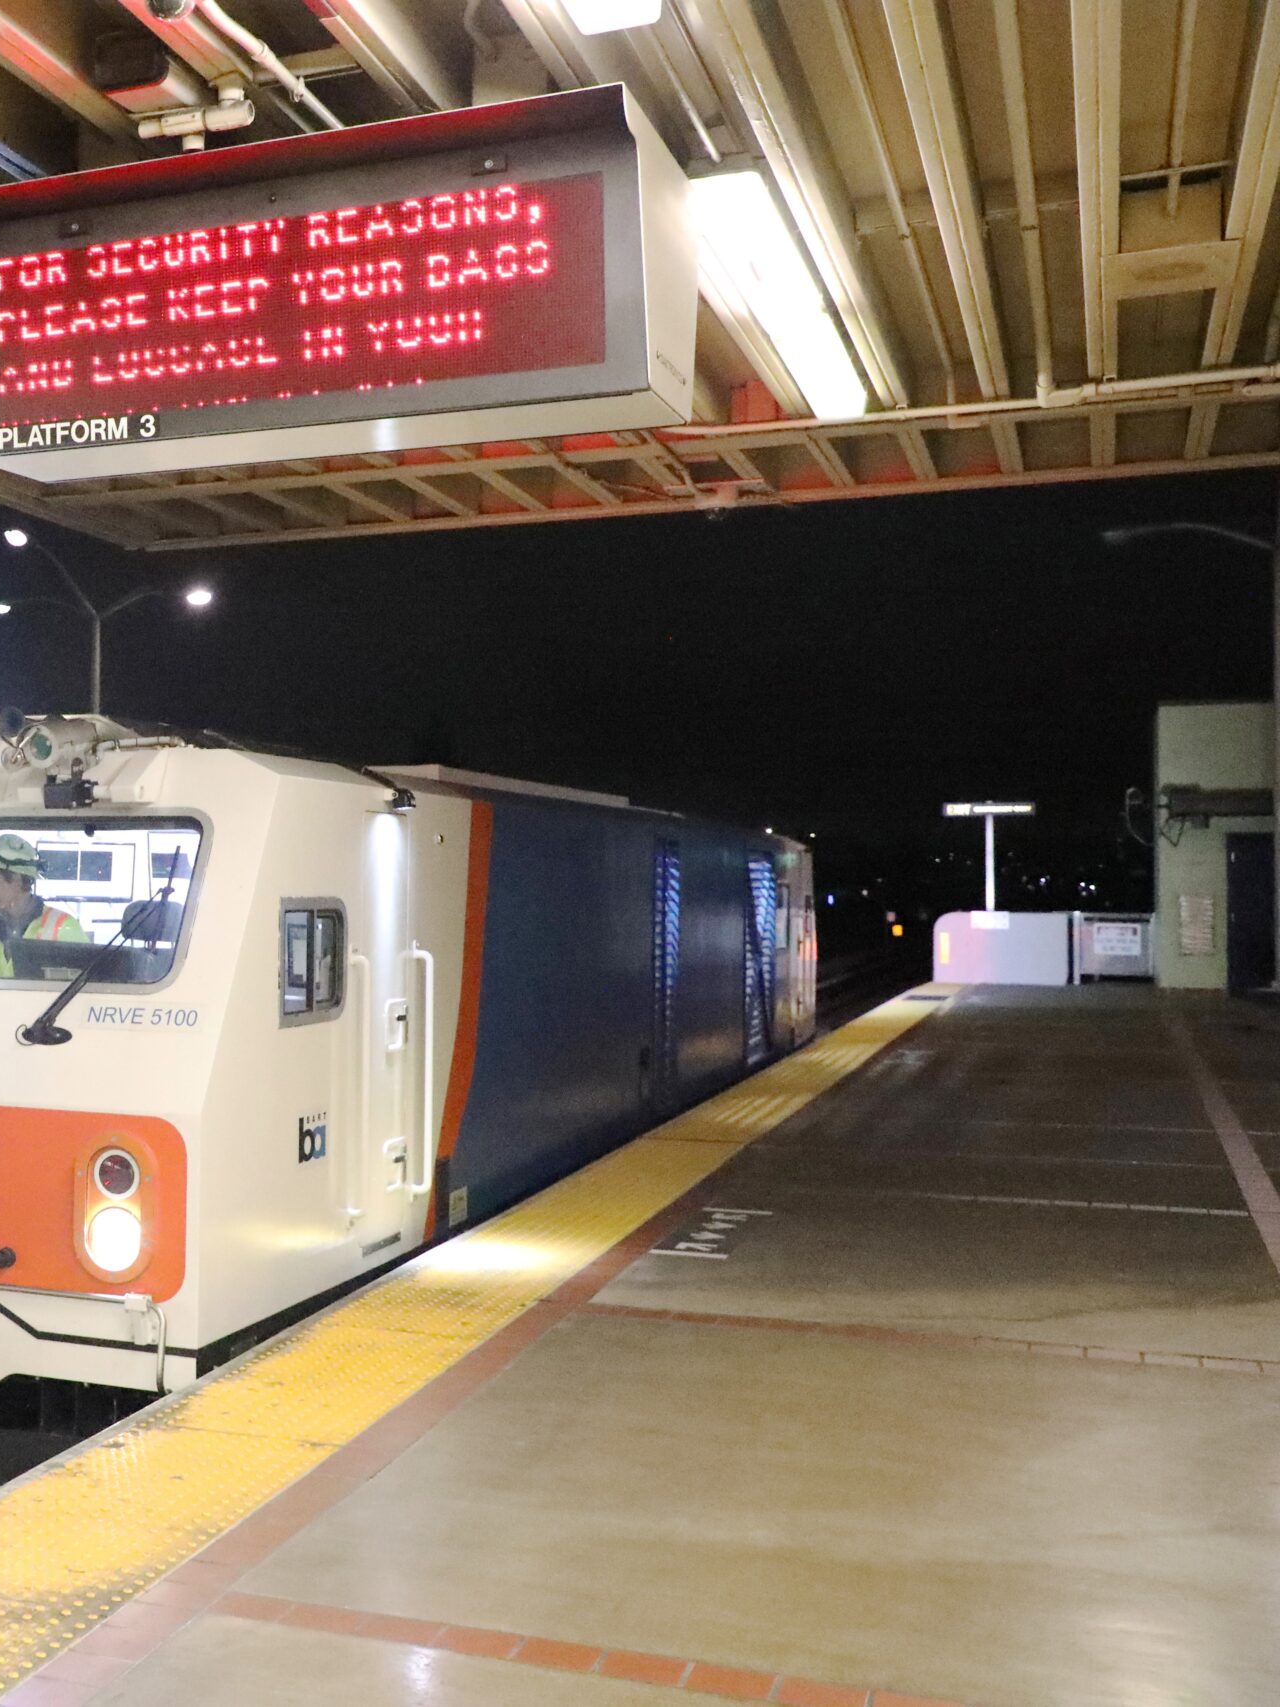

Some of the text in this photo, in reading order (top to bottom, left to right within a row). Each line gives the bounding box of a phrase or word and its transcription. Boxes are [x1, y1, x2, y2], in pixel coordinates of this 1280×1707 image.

[139, 414, 156, 438] 3
[87, 1006, 198, 1027] NRVE 5100
